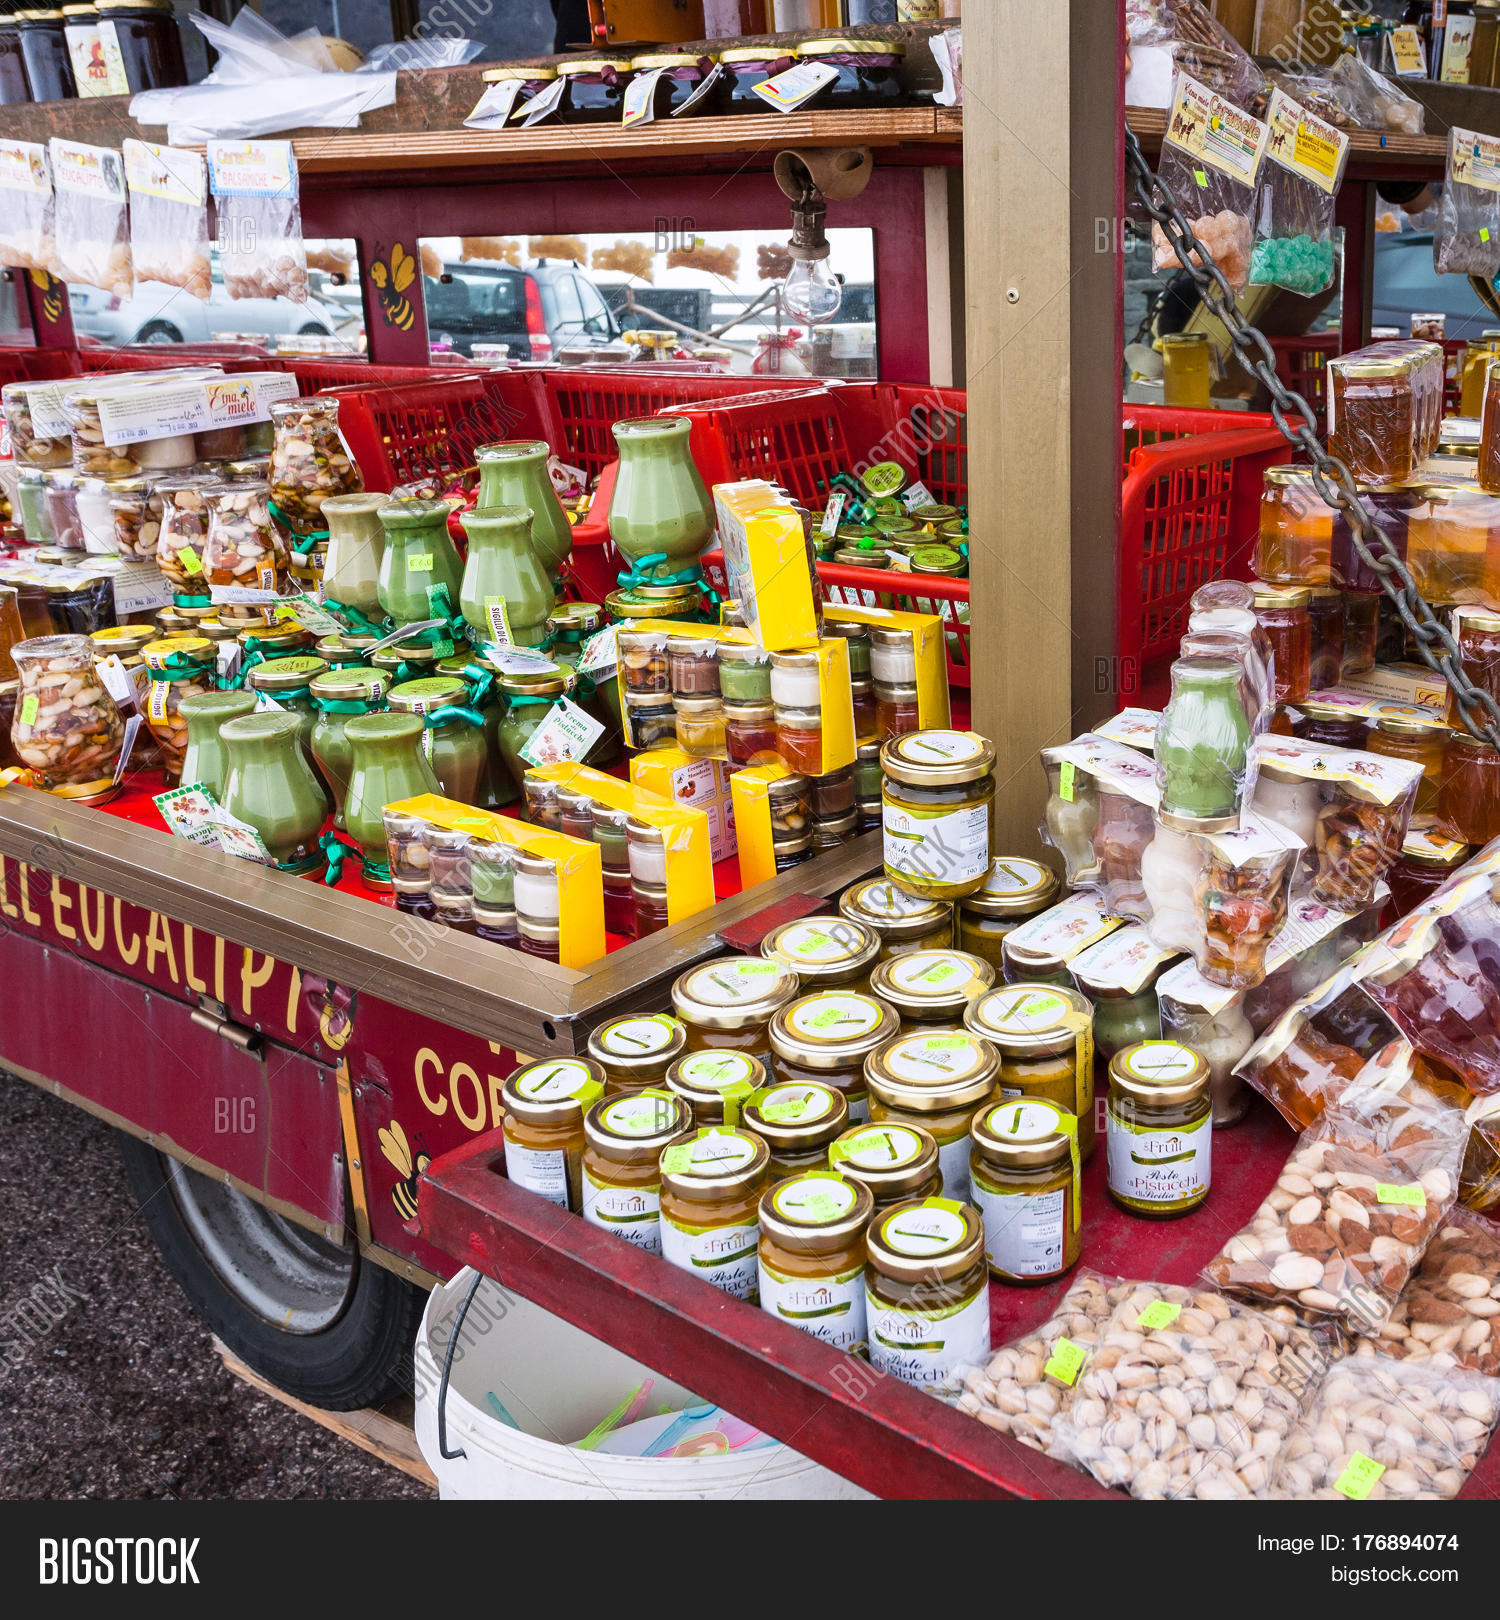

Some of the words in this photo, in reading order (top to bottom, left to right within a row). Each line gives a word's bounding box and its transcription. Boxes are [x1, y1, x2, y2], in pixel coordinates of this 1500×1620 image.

[1209, 95, 1261, 142] Caramelle
[228, 395, 256, 415] miele
[492, 607, 504, 632] SIGILLO
[553, 717, 586, 744] Pistacchi
[565, 711, 588, 732] Crema
[712, 849, 723, 859] 2011
[1134, 1172, 1199, 1191] Pistacchi
[711, 1232, 746, 1253] Fruit
[709, 1267, 746, 1283] Pesto
[1034, 1263, 1047, 1273] 90
[795, 1287, 833, 1306] Fruit
